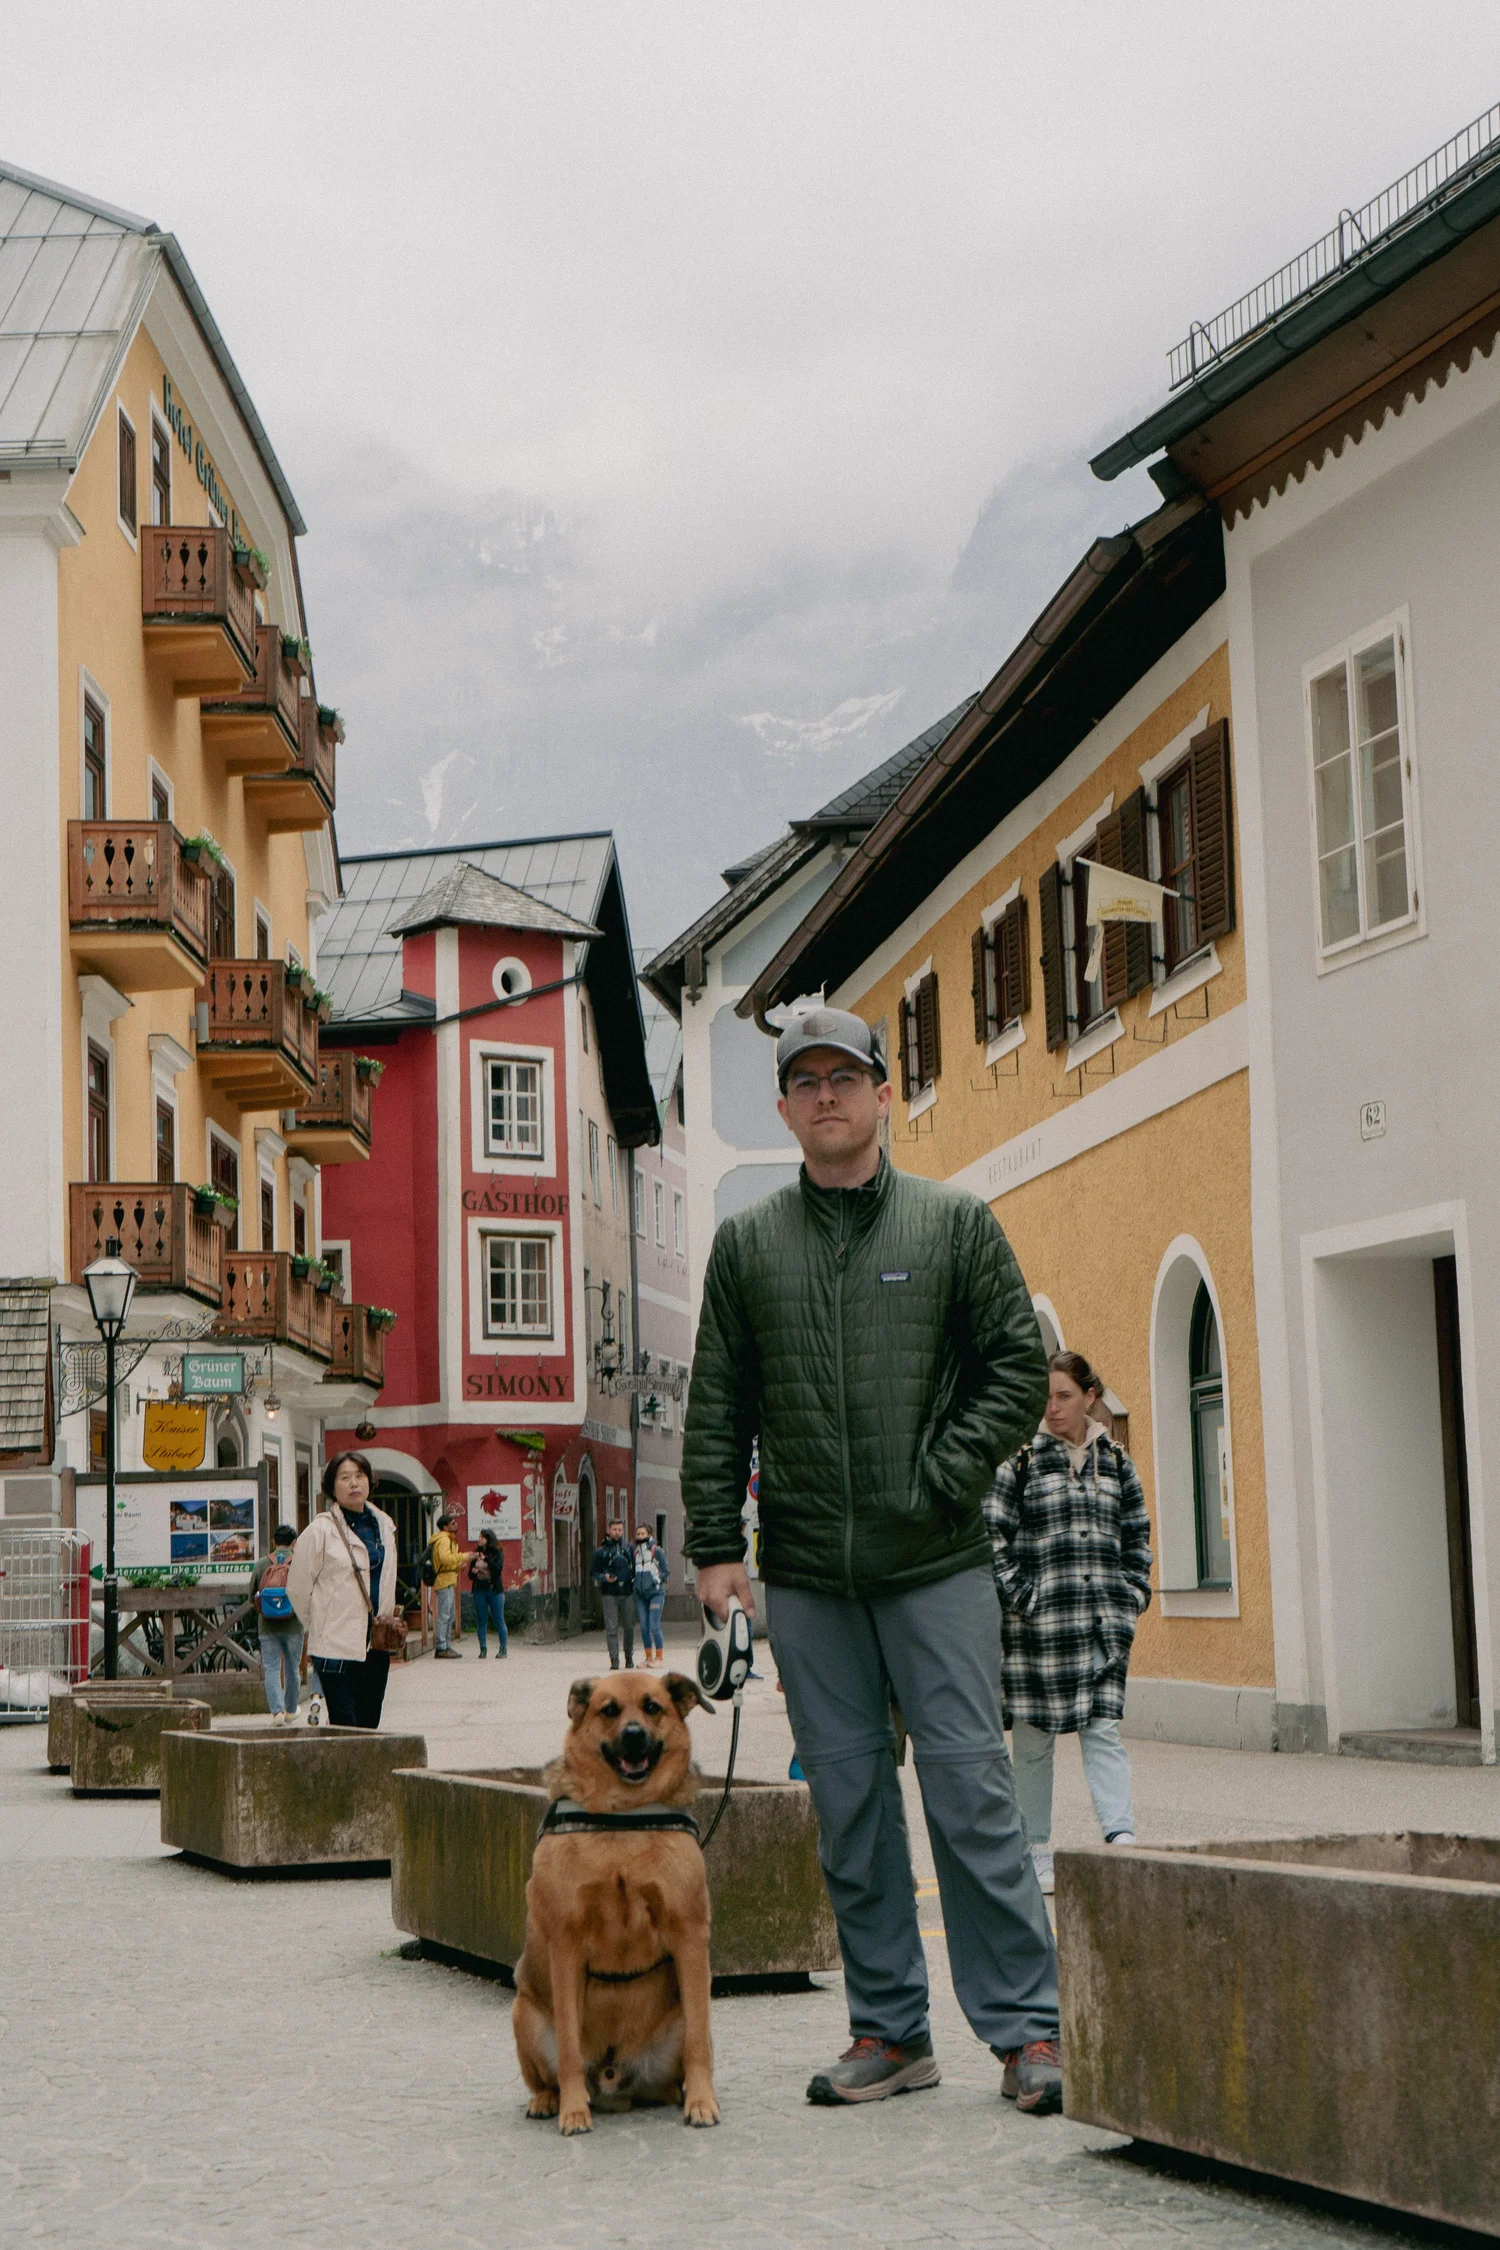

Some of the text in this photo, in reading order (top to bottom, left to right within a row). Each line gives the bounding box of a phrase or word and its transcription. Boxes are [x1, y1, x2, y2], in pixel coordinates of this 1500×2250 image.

[163, 374, 192, 464] Hotel
[1366, 1105, 1380, 1127] 62
[988, 1137, 1042, 1185] RESTAURANT
[461, 1189, 570, 1216] GASTHOF
[189, 1359, 237, 1373] Grüner
[192, 1375, 232, 1389] Baum
[466, 1373, 569, 1397] SIMONY
[149, 1420, 199, 1434] Kaiser
[146, 1445, 200, 1460] Stüberl
[169, 1564, 190, 1574] lake
[193, 1564, 213, 1574] side
[215, 1563, 250, 1573] terrace
